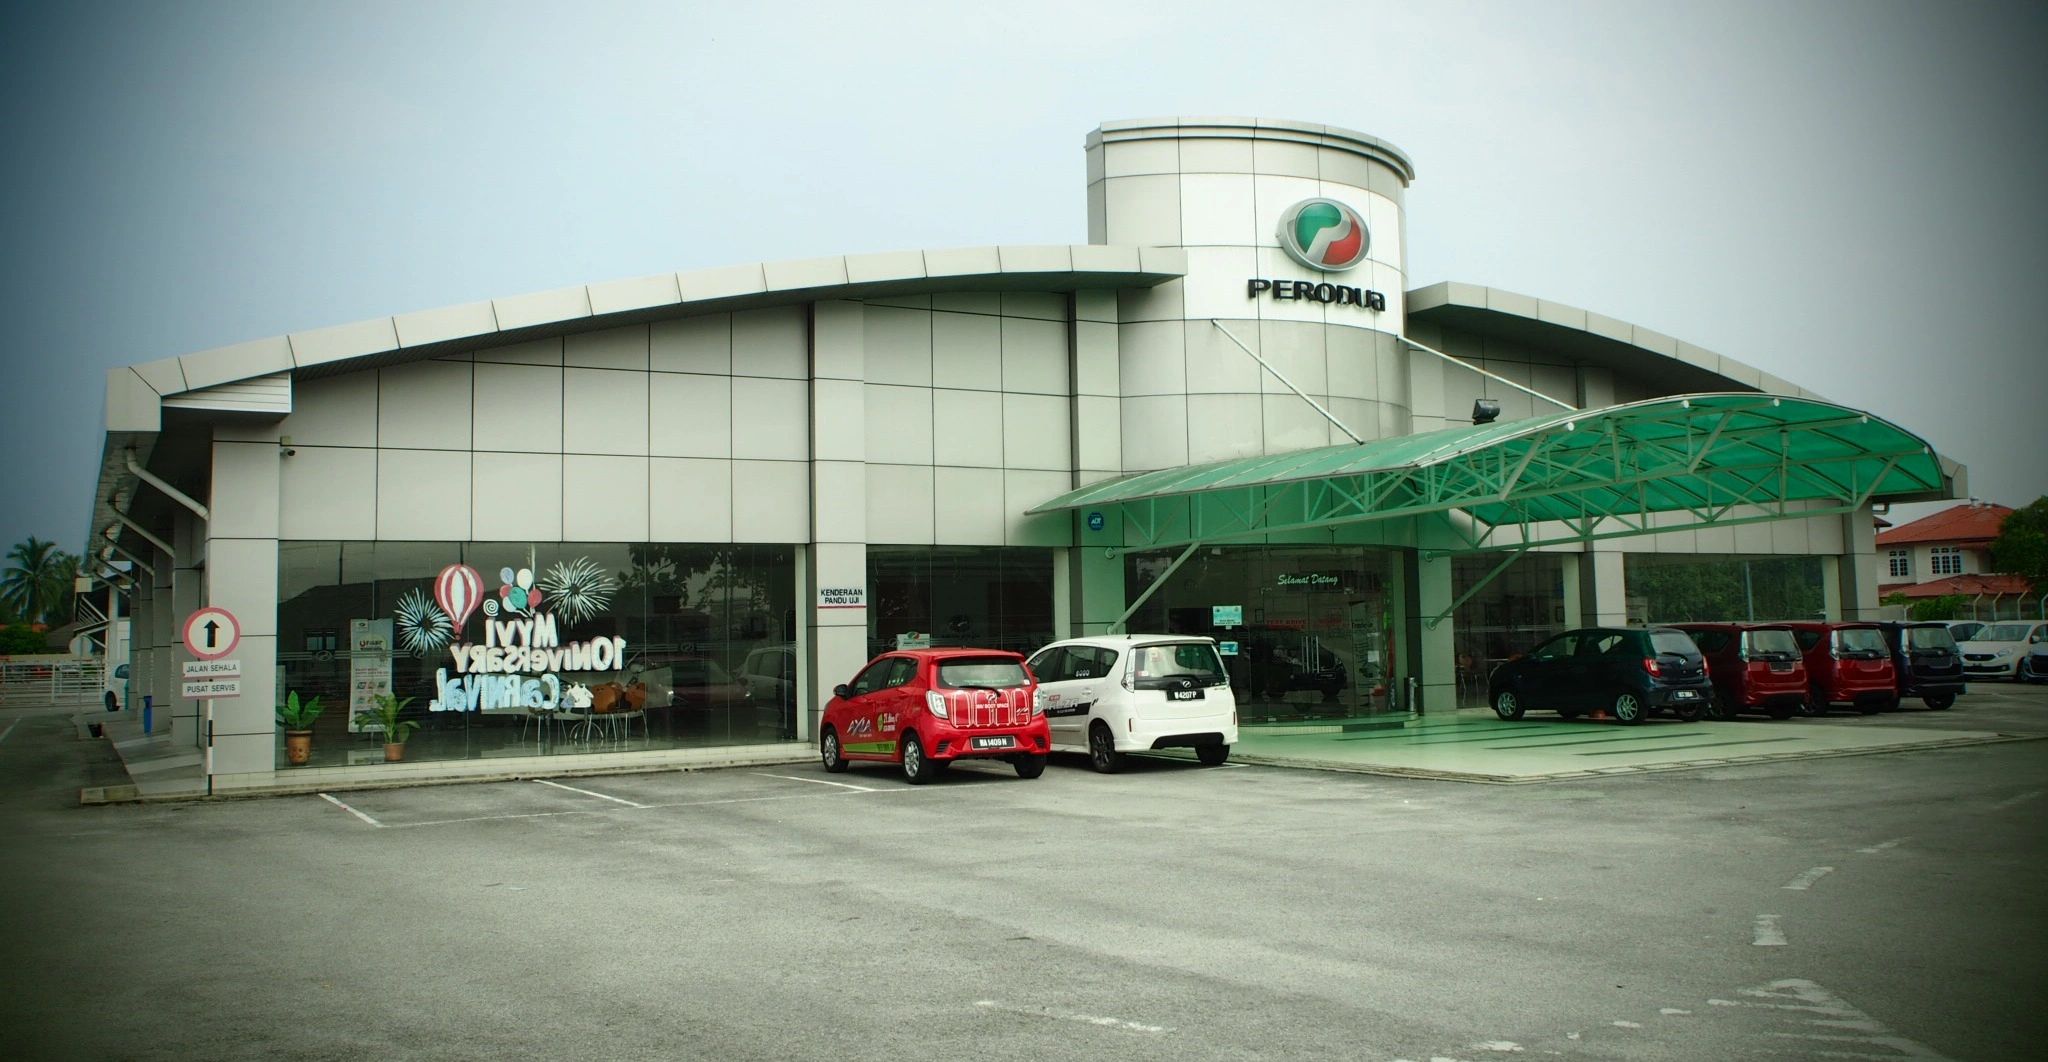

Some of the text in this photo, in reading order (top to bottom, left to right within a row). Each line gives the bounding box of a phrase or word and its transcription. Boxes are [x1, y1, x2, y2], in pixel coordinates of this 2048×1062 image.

[1277, 573, 1339, 586] Selamat Datang
[820, 588, 863, 597] KENDERAAN
[186, 665, 208, 673] JALAN
